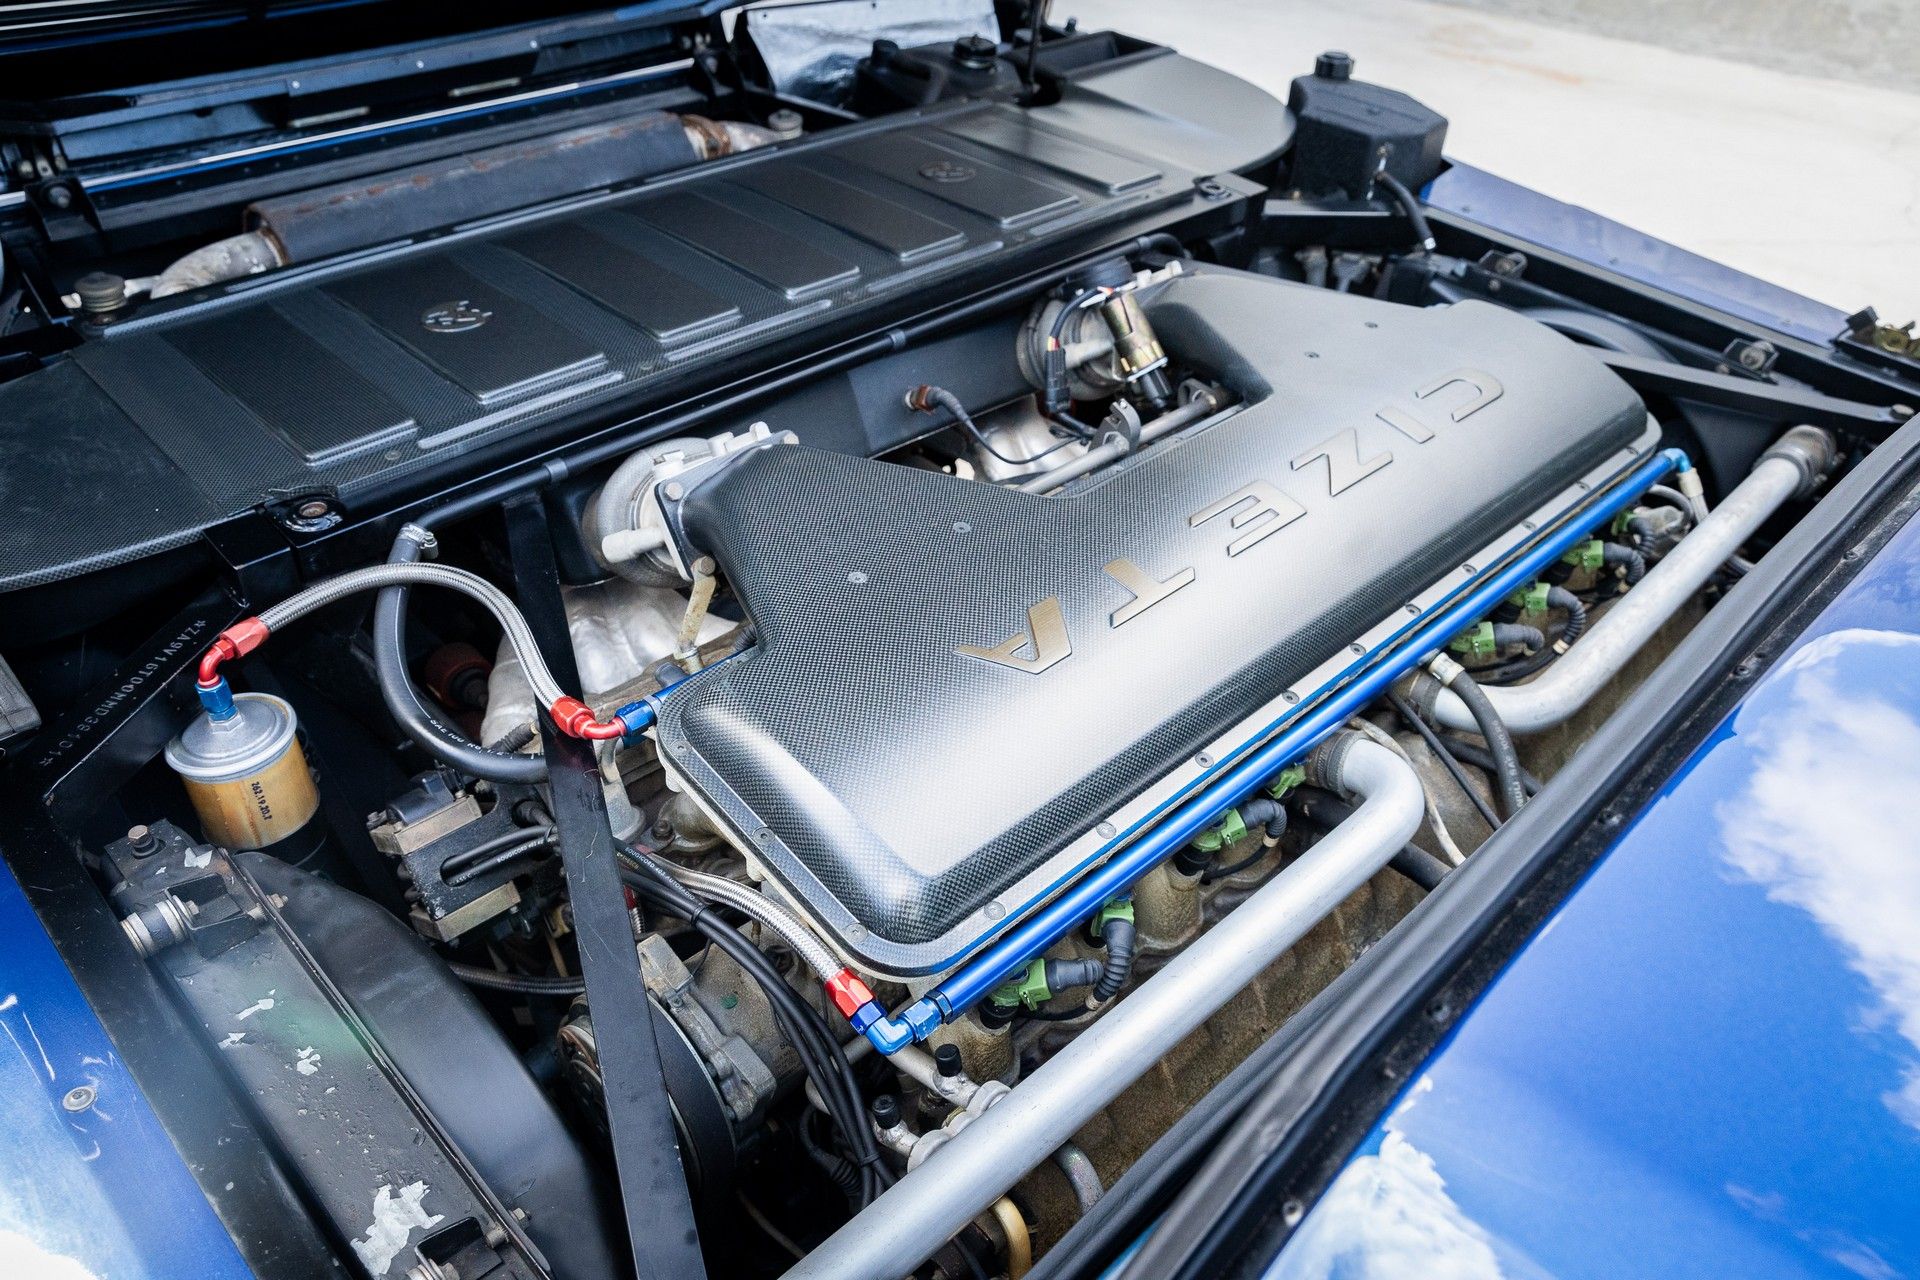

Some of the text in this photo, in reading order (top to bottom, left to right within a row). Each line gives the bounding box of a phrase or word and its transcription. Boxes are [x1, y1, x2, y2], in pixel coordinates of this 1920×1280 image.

[951, 368, 1505, 675] CIZETA
[430, 719, 448, 733] SAE
[625, 846, 656, 868] BOUGICORD
[665, 875, 696, 901] AUTORADIO
